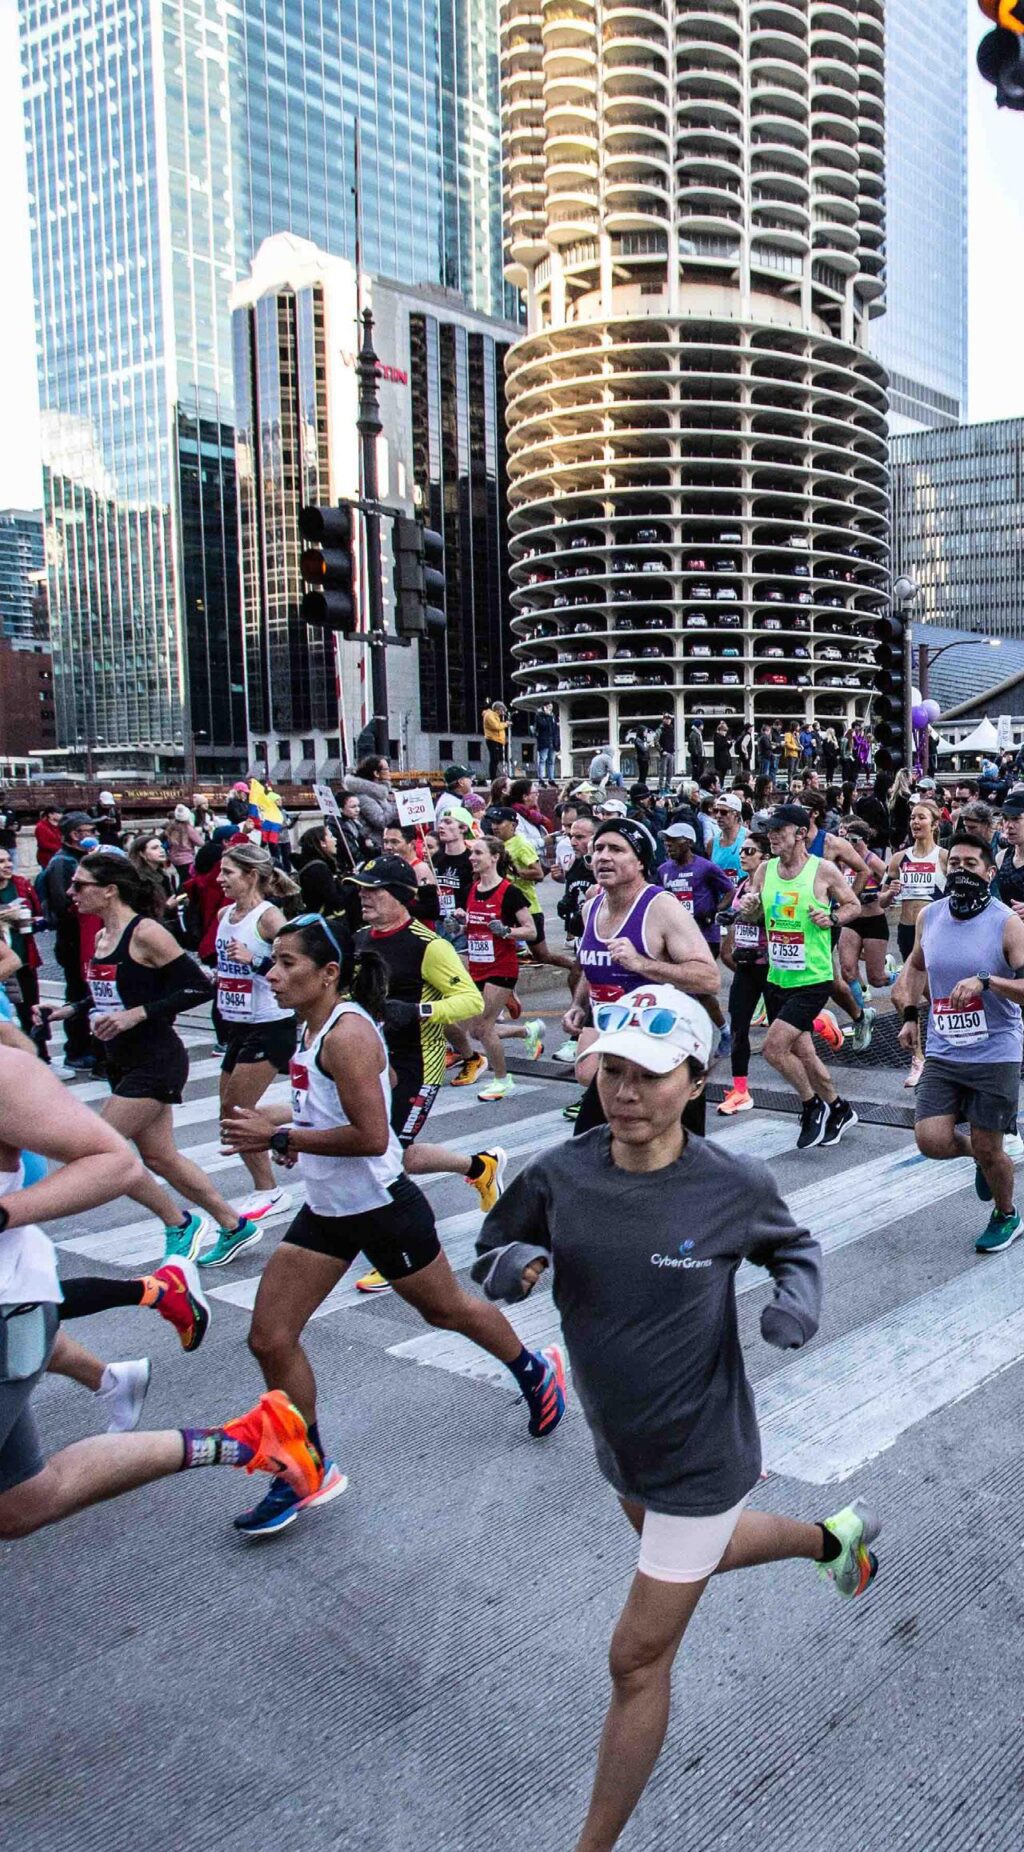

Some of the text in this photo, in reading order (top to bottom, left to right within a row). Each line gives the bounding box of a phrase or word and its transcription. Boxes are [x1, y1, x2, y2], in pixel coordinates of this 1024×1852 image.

[407, 805, 426, 815] 3:20
[910, 873, 932, 883] 10710
[772, 943, 799, 957] C 7532
[937, 1012, 981, 1030] C 12150
